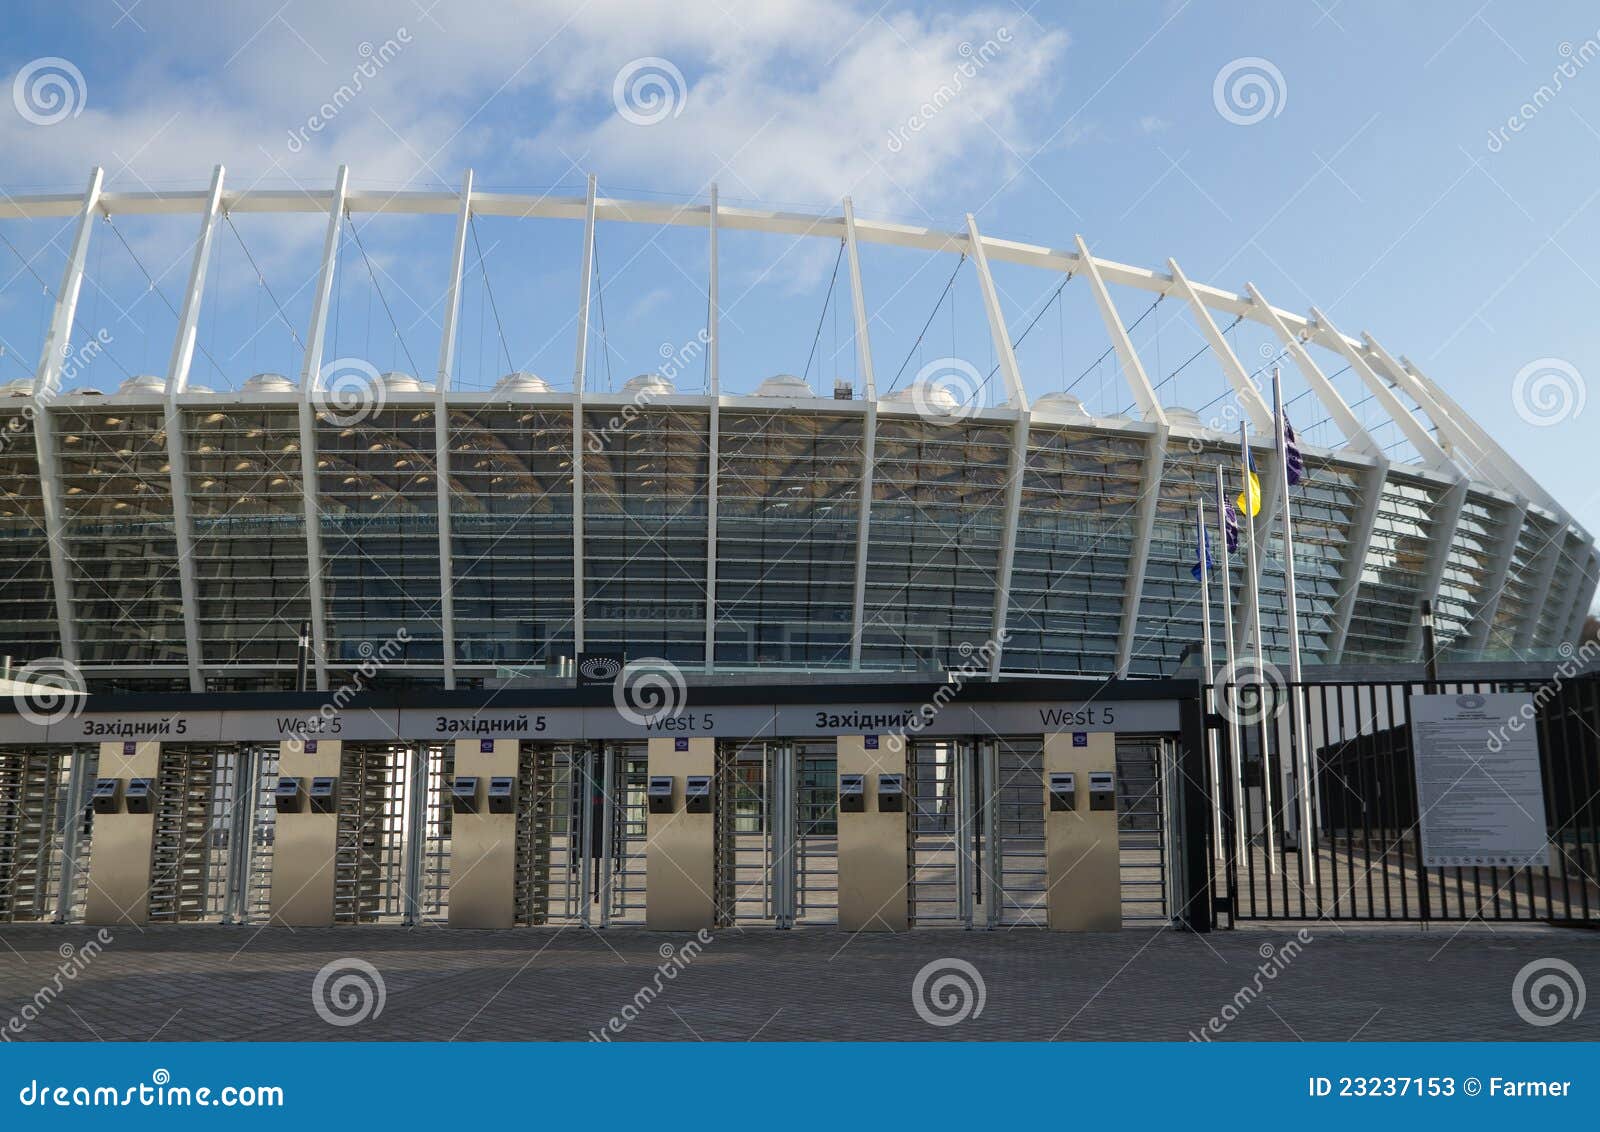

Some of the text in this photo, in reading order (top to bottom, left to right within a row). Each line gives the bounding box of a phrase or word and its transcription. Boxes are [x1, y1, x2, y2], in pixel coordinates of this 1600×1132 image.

[277, 717, 342, 733] West 5
[436, 715, 546, 734] Західний 5
[643, 714, 714, 731] West 5
[815, 710, 917, 730] Західний
[1040, 707, 1114, 726] West 5
[83, 719, 187, 737] Західний 5
